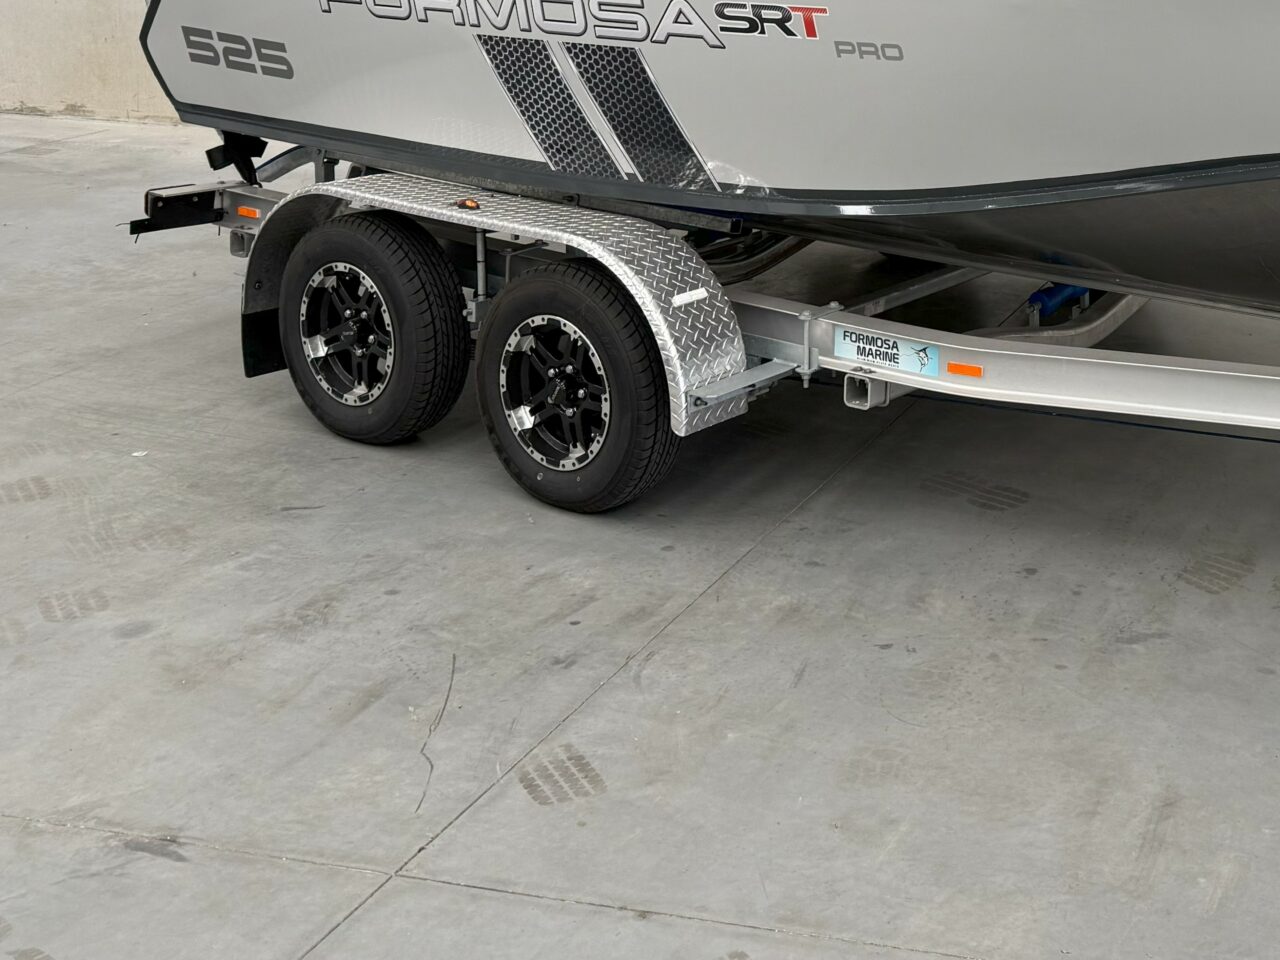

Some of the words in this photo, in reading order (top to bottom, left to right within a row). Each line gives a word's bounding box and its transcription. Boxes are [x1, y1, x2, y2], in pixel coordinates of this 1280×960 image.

[714, 1, 829, 40] SRT
[181, 25, 294, 80] 525
[834, 40, 904, 61] PRO
[843, 330, 899, 352] FORMOSA
[856, 345, 900, 365] MARINE
